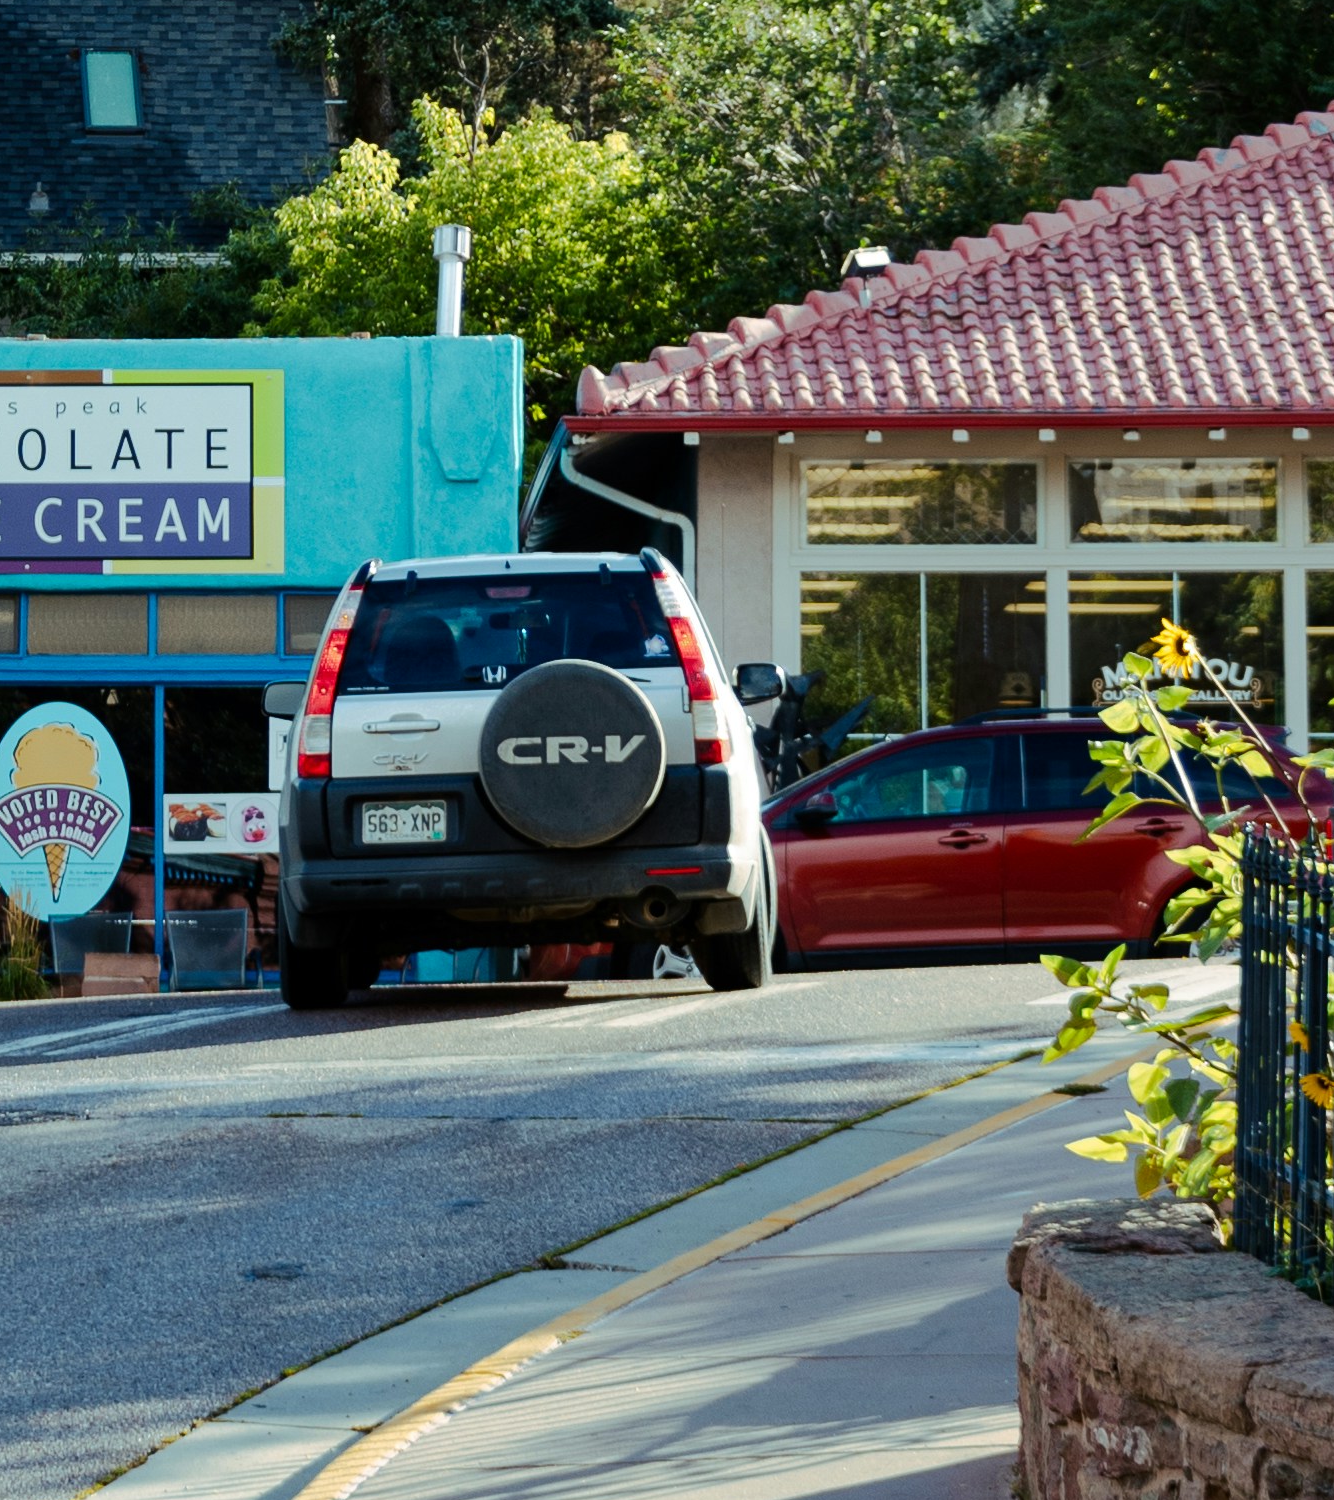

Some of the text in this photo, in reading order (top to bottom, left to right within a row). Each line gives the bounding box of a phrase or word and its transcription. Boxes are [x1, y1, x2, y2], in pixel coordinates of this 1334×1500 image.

[55, 397, 149, 418] peak
[33, 497, 231, 544] CREAM
[372, 752, 430, 766] CR-V
[496, 734, 647, 765] CR-V
[66, 790, 115, 826] BEST
[49, 811, 96, 832] cream
[49, 825, 59, 838] &
